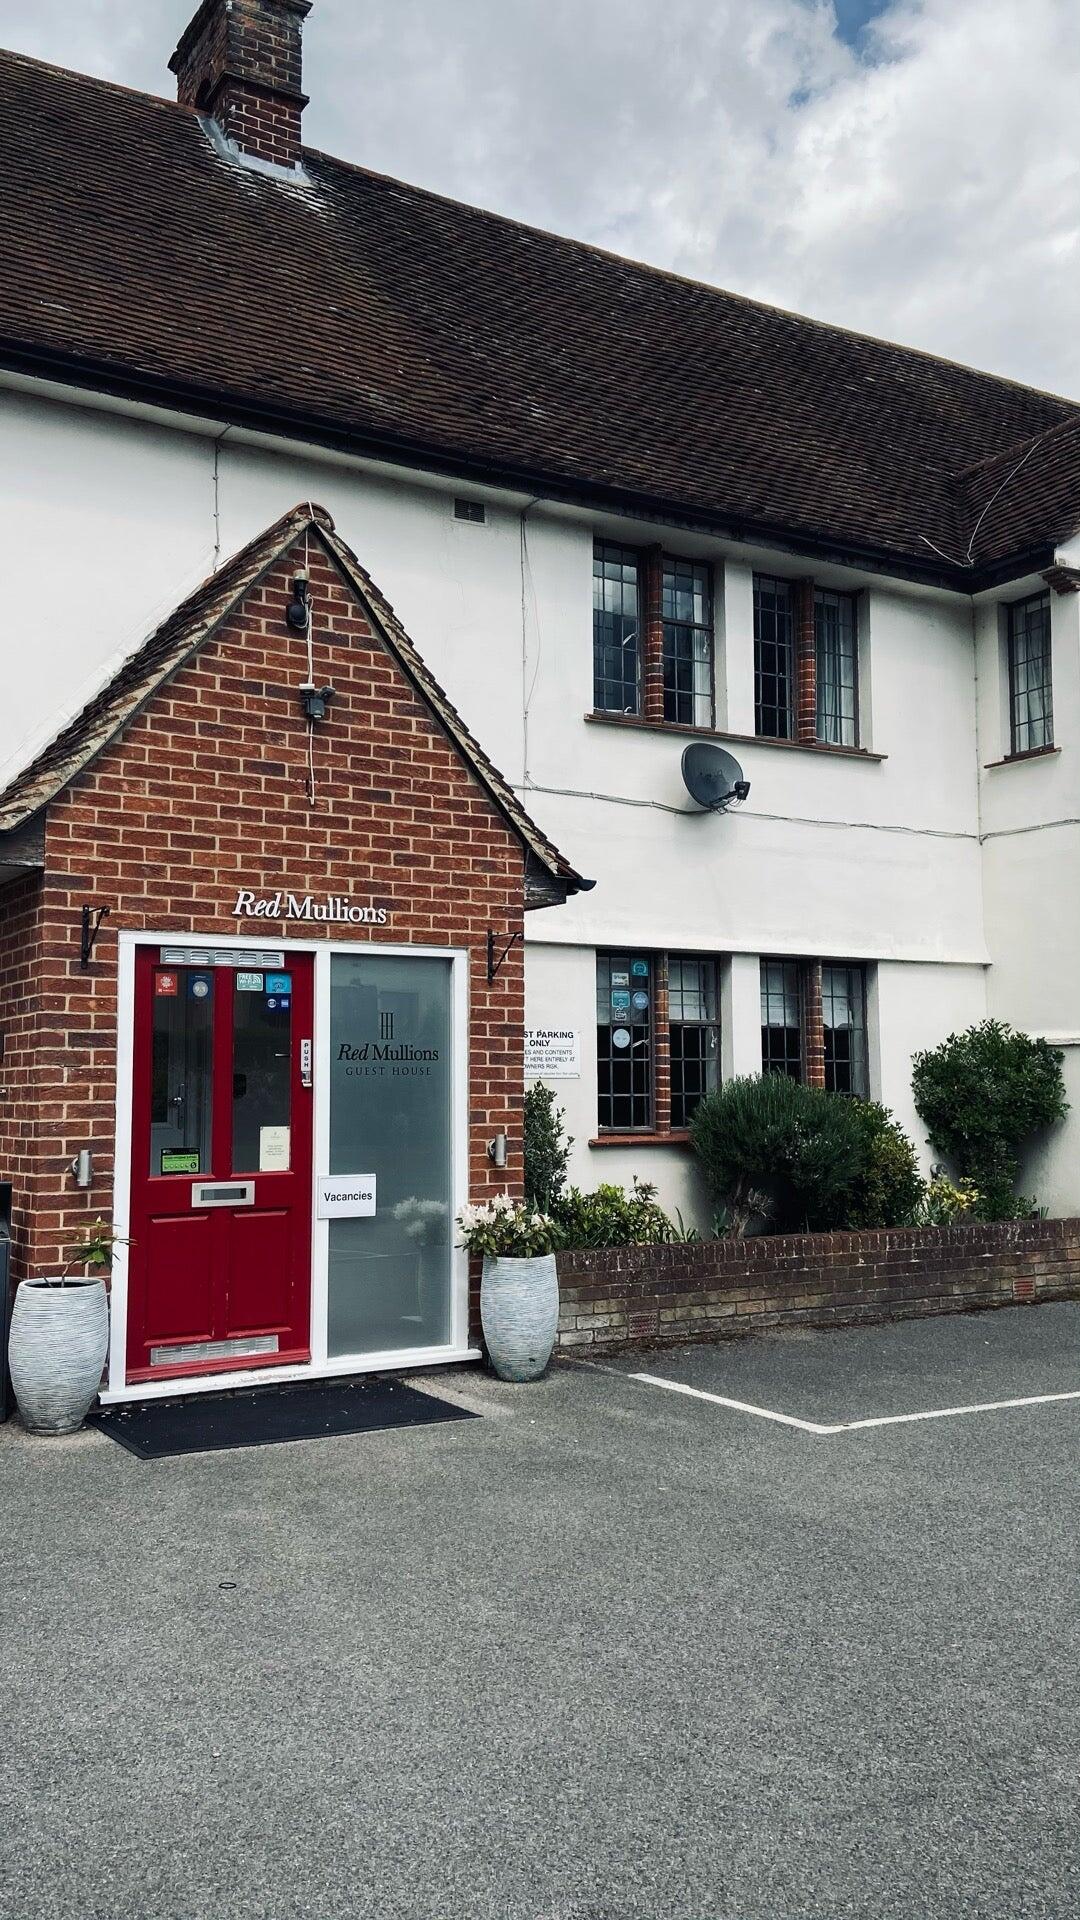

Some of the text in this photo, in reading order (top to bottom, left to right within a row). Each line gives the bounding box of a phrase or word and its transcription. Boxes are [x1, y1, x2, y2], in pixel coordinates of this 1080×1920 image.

[232, 890, 387, 924] Red Mullions
[536, 1031, 574, 1039] PARKING
[529, 1039, 551, 1047] ONLY
[337, 1043, 439, 1061] Red Mullions
[345, 1066, 432, 1076] GUEST HOUSE
[323, 1190, 373, 1202] Vacancies
